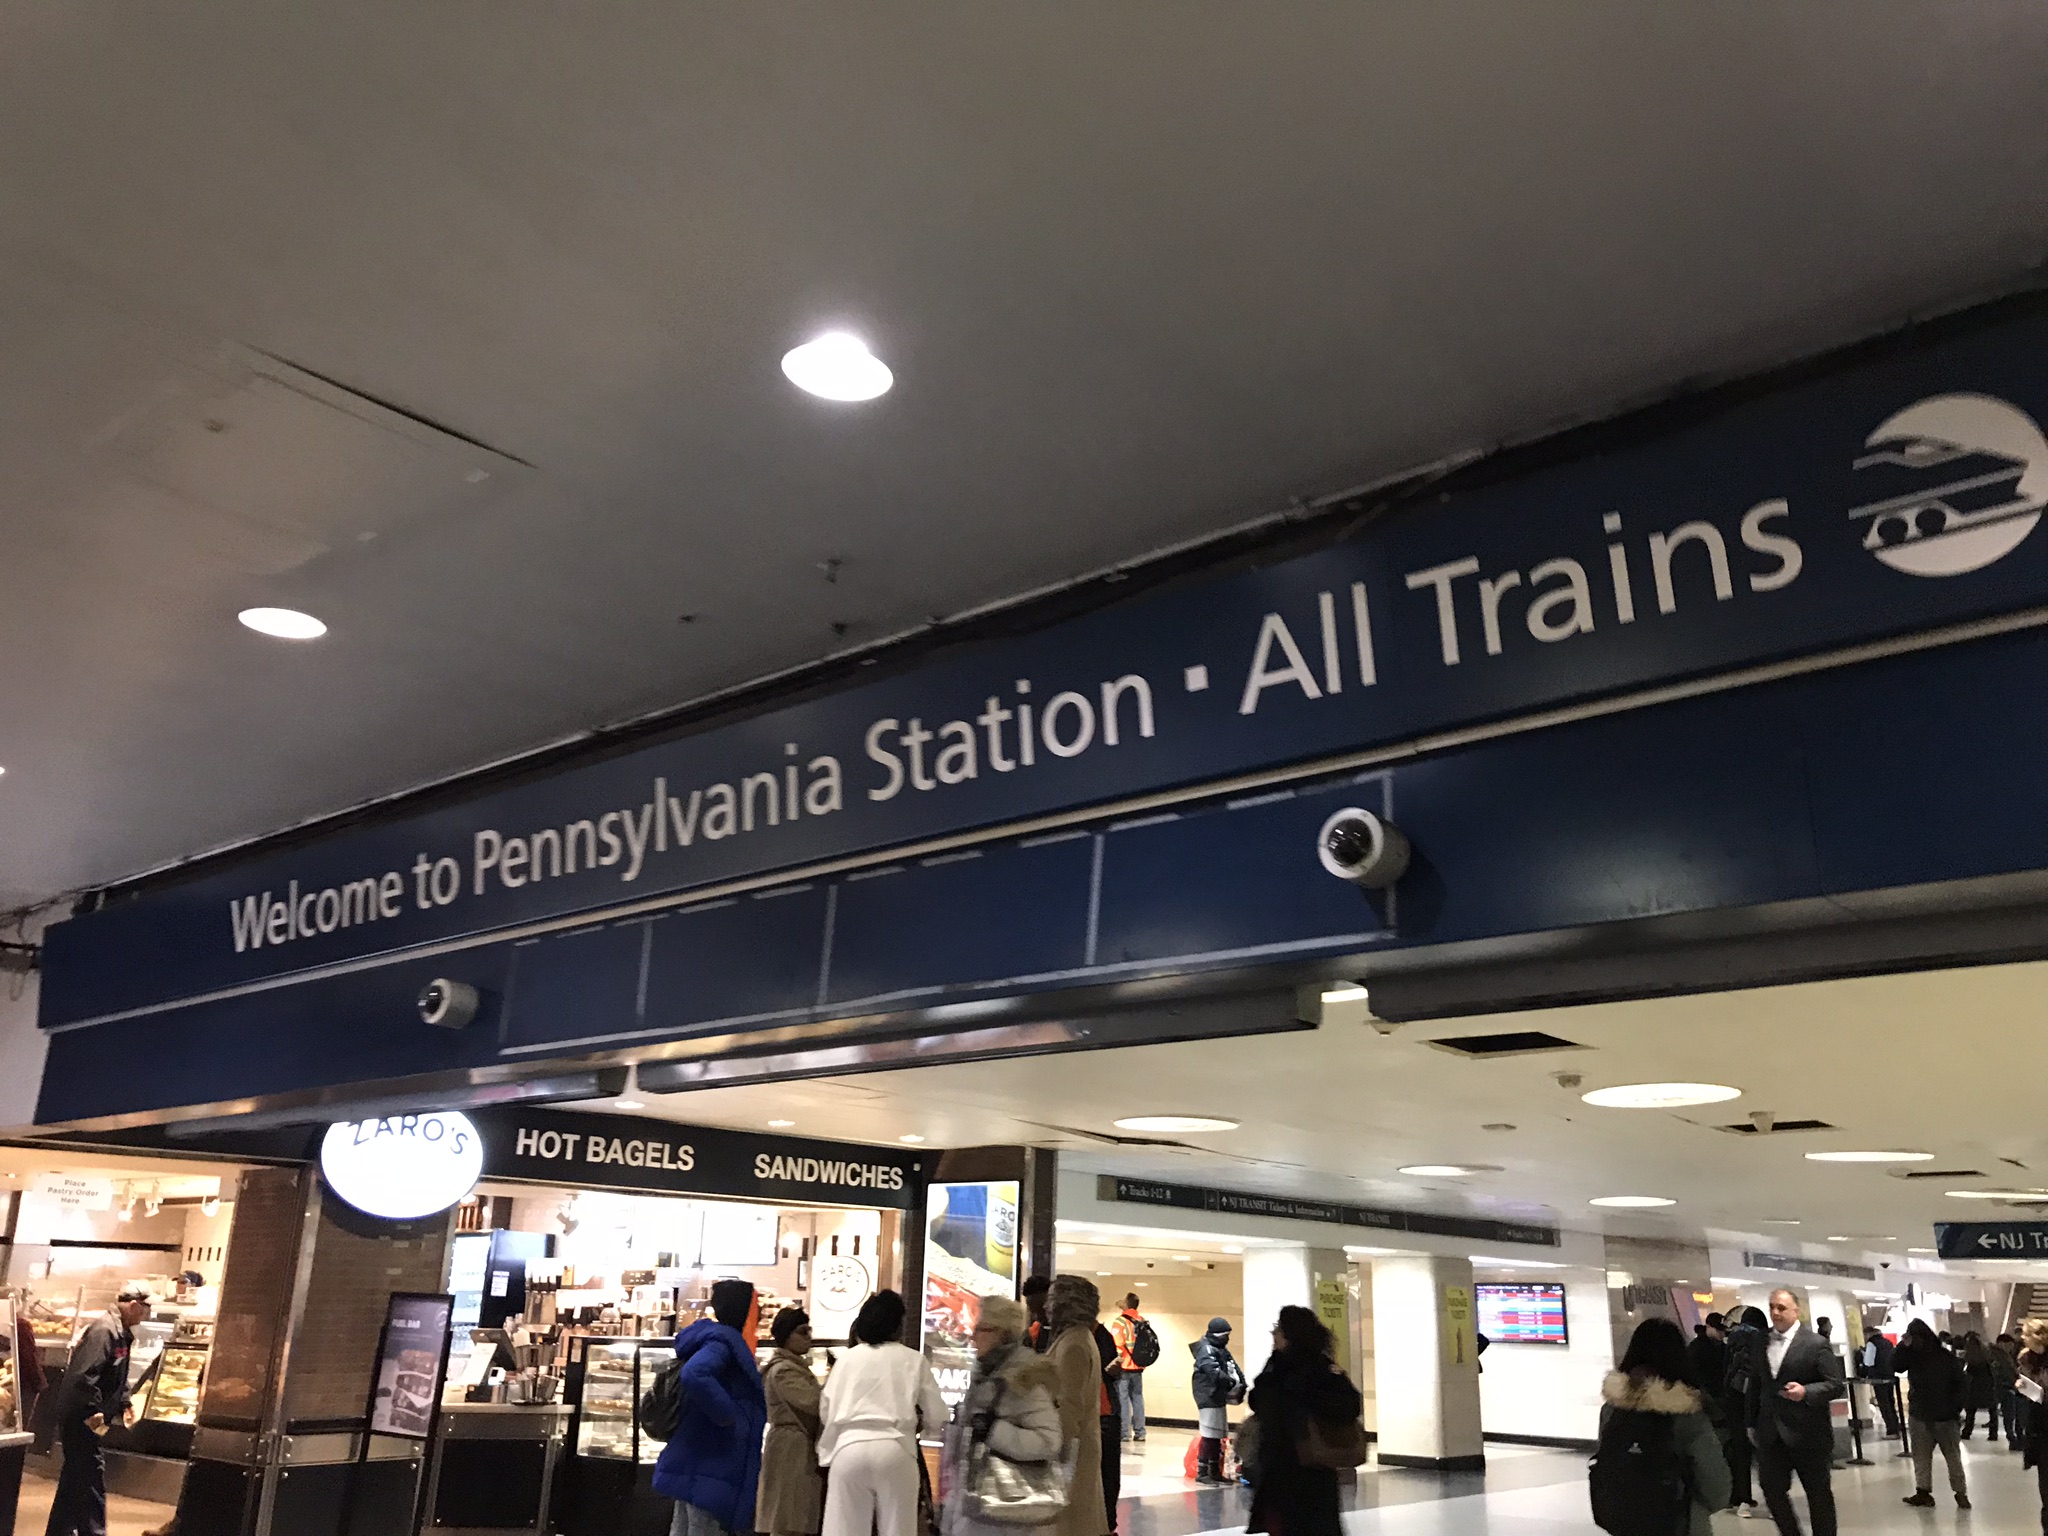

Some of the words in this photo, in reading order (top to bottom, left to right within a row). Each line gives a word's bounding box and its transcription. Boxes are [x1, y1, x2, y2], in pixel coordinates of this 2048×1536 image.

[230, 870, 404, 952] Welcome
[412, 853, 461, 911] to
[473, 741, 844, 896] Pennsylvania
[866, 673, 1156, 802] Station
[1238, 581, 1378, 717] All
[1404, 498, 1804, 667] Trains
[347, 1114, 469, 1155] ZARO'S
[515, 1127, 581, 1161] HOT
[585, 1135, 696, 1172] BAGELS
[753, 1152, 905, 1191] SANDWICHES
[64, 1179, 87, 1187] Place
[47, 1187, 73, 1196] Pastry
[75, 1188, 99, 1197] Order
[61, 1196, 80, 1204] Here
[1239, 1197, 1267, 1211] TRANSIT
[2000, 1232, 2024, 1249] NJ
